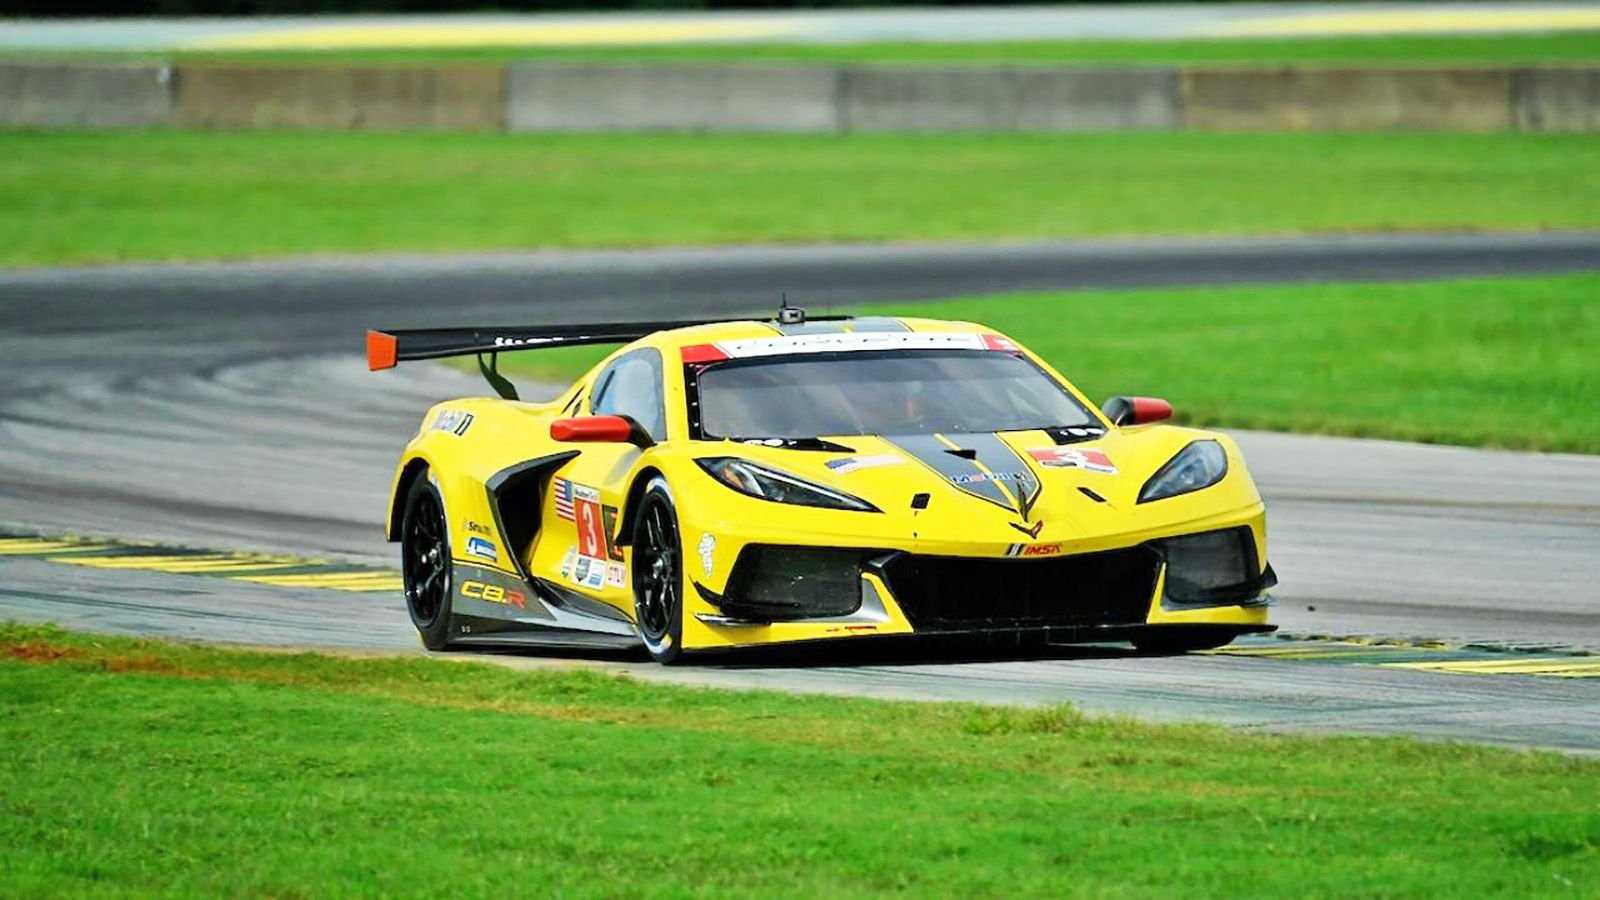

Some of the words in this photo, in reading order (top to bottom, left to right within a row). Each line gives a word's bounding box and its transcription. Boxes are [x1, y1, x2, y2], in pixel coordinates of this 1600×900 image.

[582, 502, 598, 557] 3
[1024, 543, 1061, 556] IMSA
[460, 581, 526, 609] C8.R
